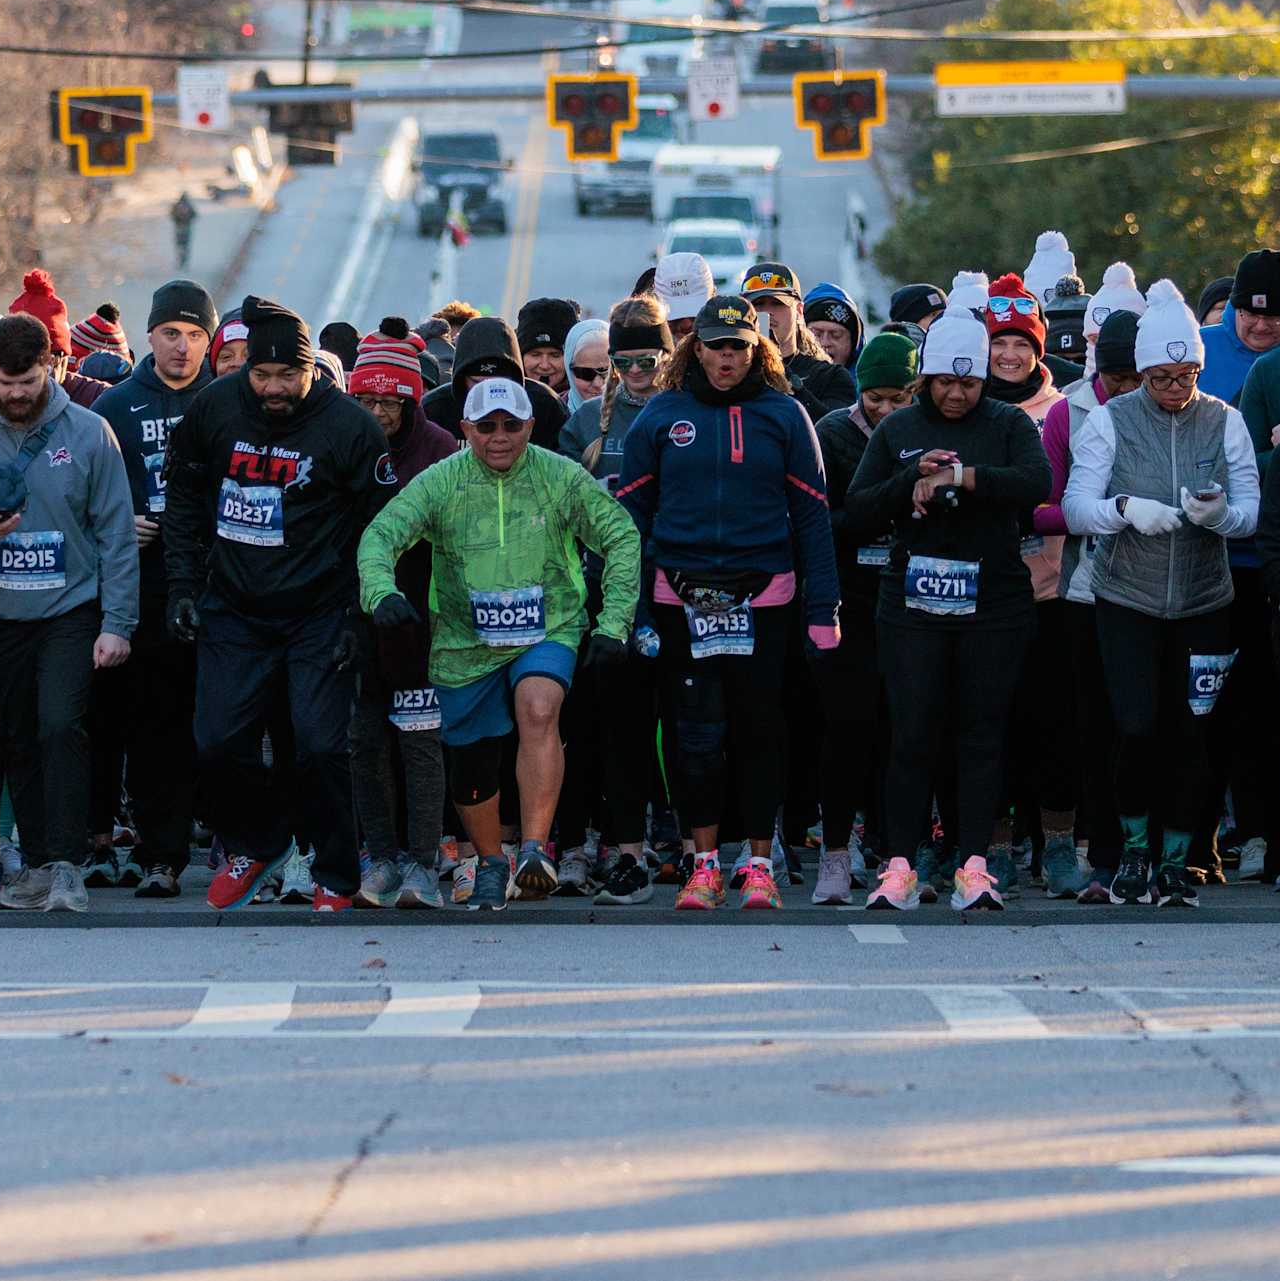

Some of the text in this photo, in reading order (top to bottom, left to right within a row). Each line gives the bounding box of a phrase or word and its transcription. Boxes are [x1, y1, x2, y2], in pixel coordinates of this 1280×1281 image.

[271, 447, 301, 460] Men
[228, 452, 298, 483] run
[223, 498, 275, 525] D3237
[1, 549, 56, 569] D2915
[916, 576, 967, 596] C4711
[476, 606, 540, 626] D3024
[694, 613, 749, 637] D2433
